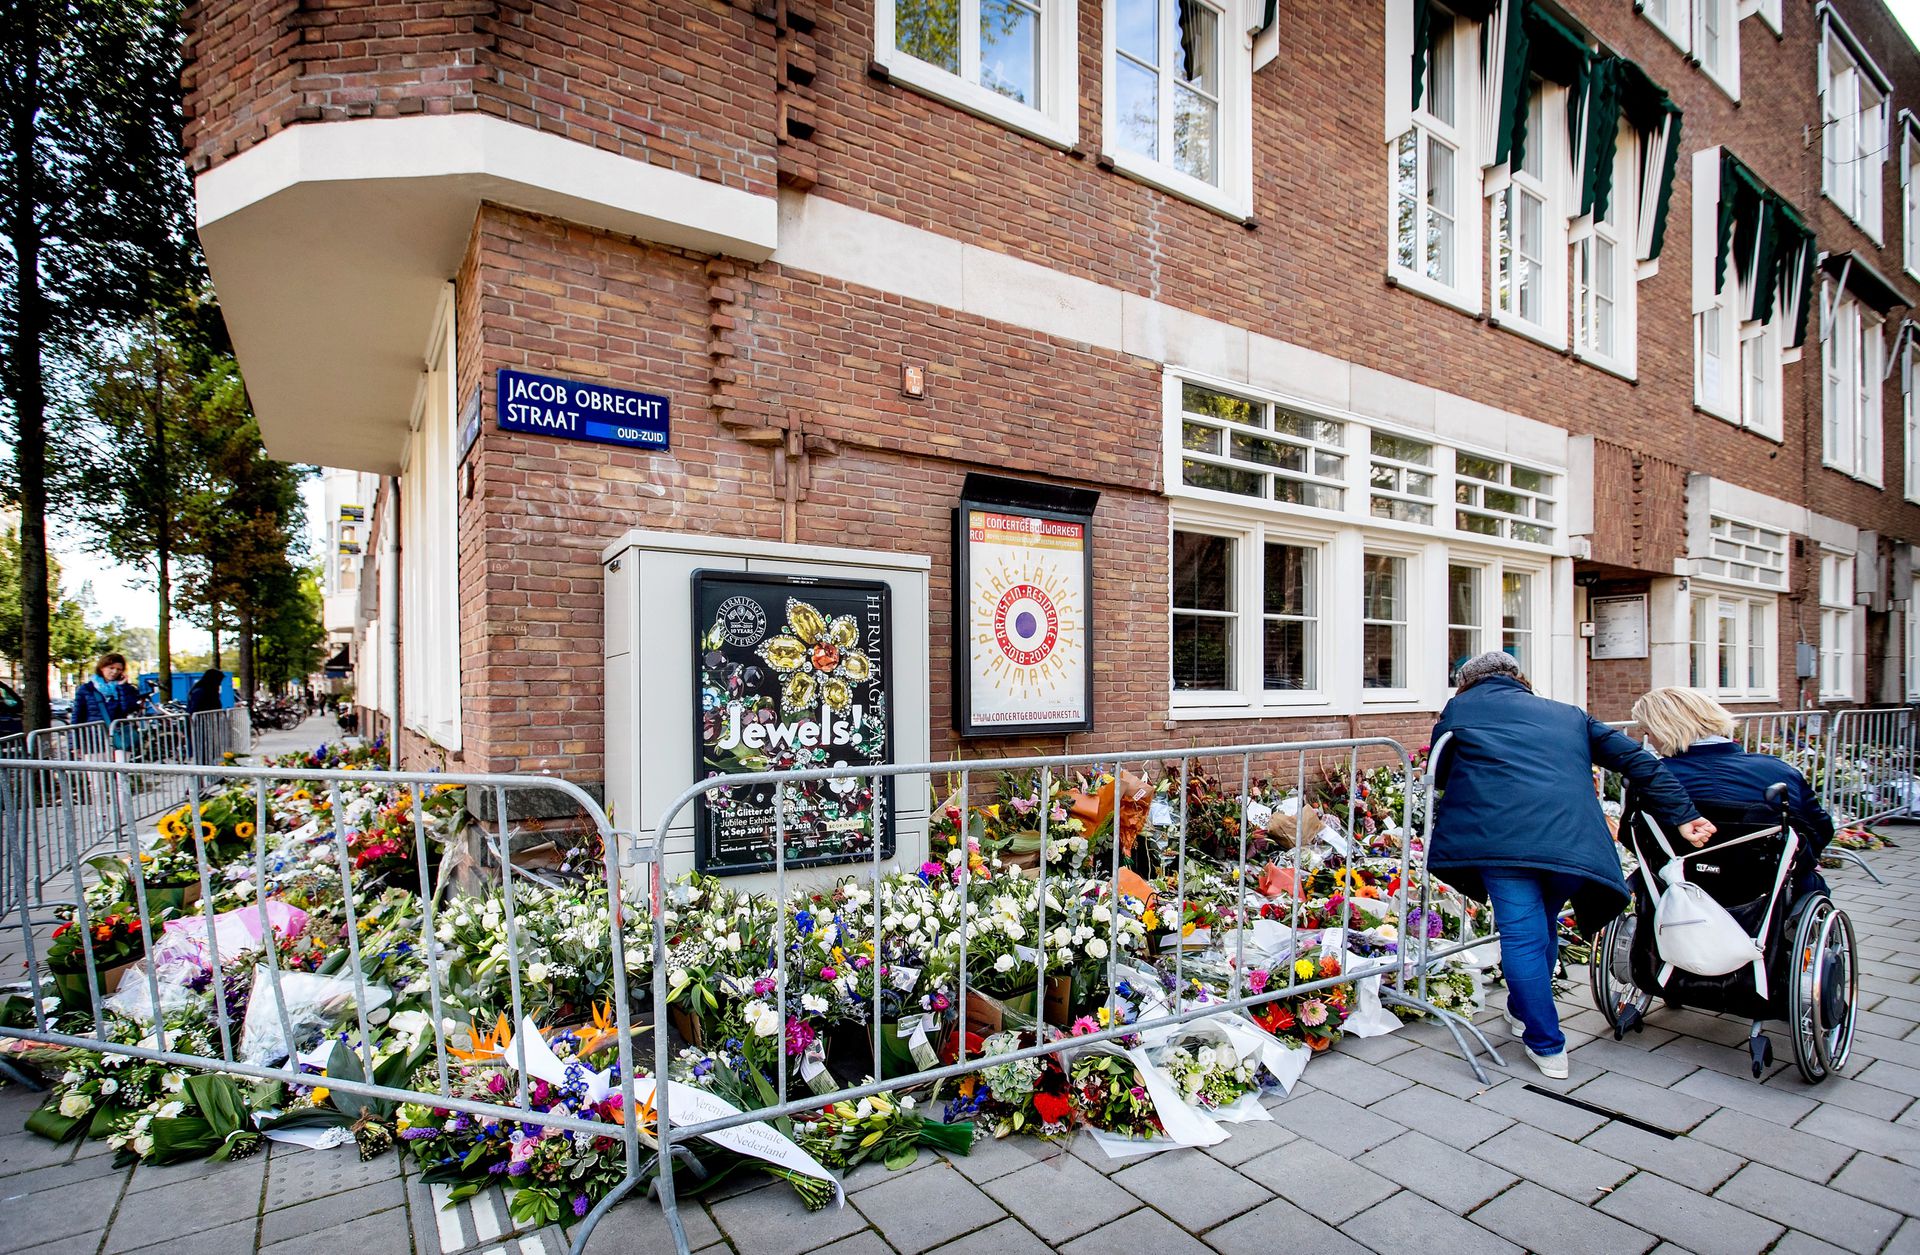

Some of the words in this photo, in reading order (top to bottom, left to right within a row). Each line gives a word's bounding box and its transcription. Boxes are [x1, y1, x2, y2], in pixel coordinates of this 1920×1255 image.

[507, 377, 568, 405] JACOB
[575, 389, 662, 420] OBRECHT
[507, 403, 580, 431] STRAAT
[617, 427, 664, 443] OUD-ZUID
[970, 530, 984, 540] RCO
[985, 517, 1079, 537] CONCERTGEBOUWORKEST
[996, 598, 1011, 638] ARTIST
[1026, 586, 1058, 640] RESIDENCE
[1023, 564, 1075, 648] LAURENT
[866, 594, 882, 714] HERMITAGE
[1002, 643, 1052, 665] 2018-2019
[991, 654, 1064, 687] AIMARD
[717, 704, 863, 750] Jewels!
[720, 809, 736, 818] The
[736, 808, 763, 817] Glitter
[764, 806, 774, 815] of
[789, 803, 817, 812] Russian
[818, 801, 840, 811] Court
[720, 818, 748, 828] Jubilee
[721, 829, 730, 837] 14
[731, 827, 746, 838] Sep
[747, 827, 764, 835] 2019
[795, 822, 811, 830] 2020
[731, 1131, 788, 1159] Nederland
[746, 1123, 784, 1144] Sociale
